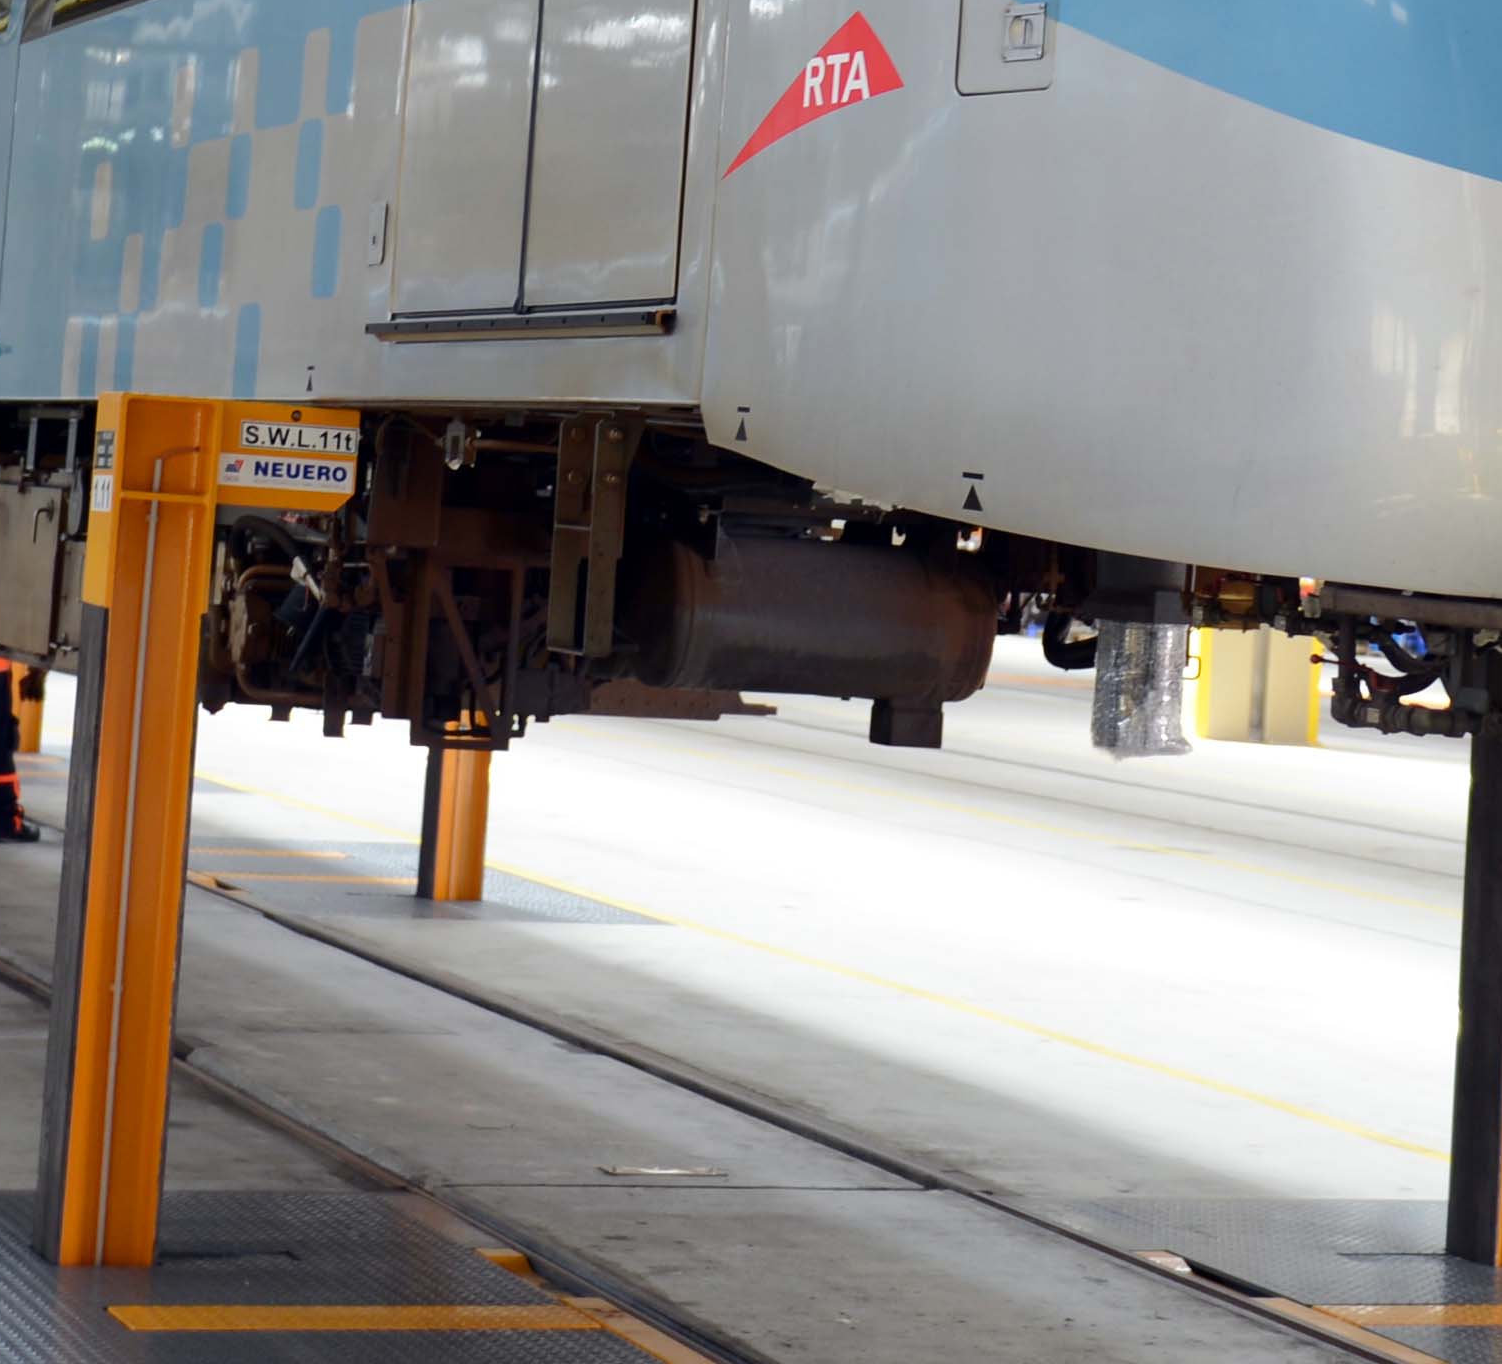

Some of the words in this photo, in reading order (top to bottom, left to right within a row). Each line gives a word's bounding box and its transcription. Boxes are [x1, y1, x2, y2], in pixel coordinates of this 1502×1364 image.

[802, 50, 871, 108] RTA
[244, 424, 354, 452] S.W.L.11t
[253, 460, 348, 483] NEUERO
